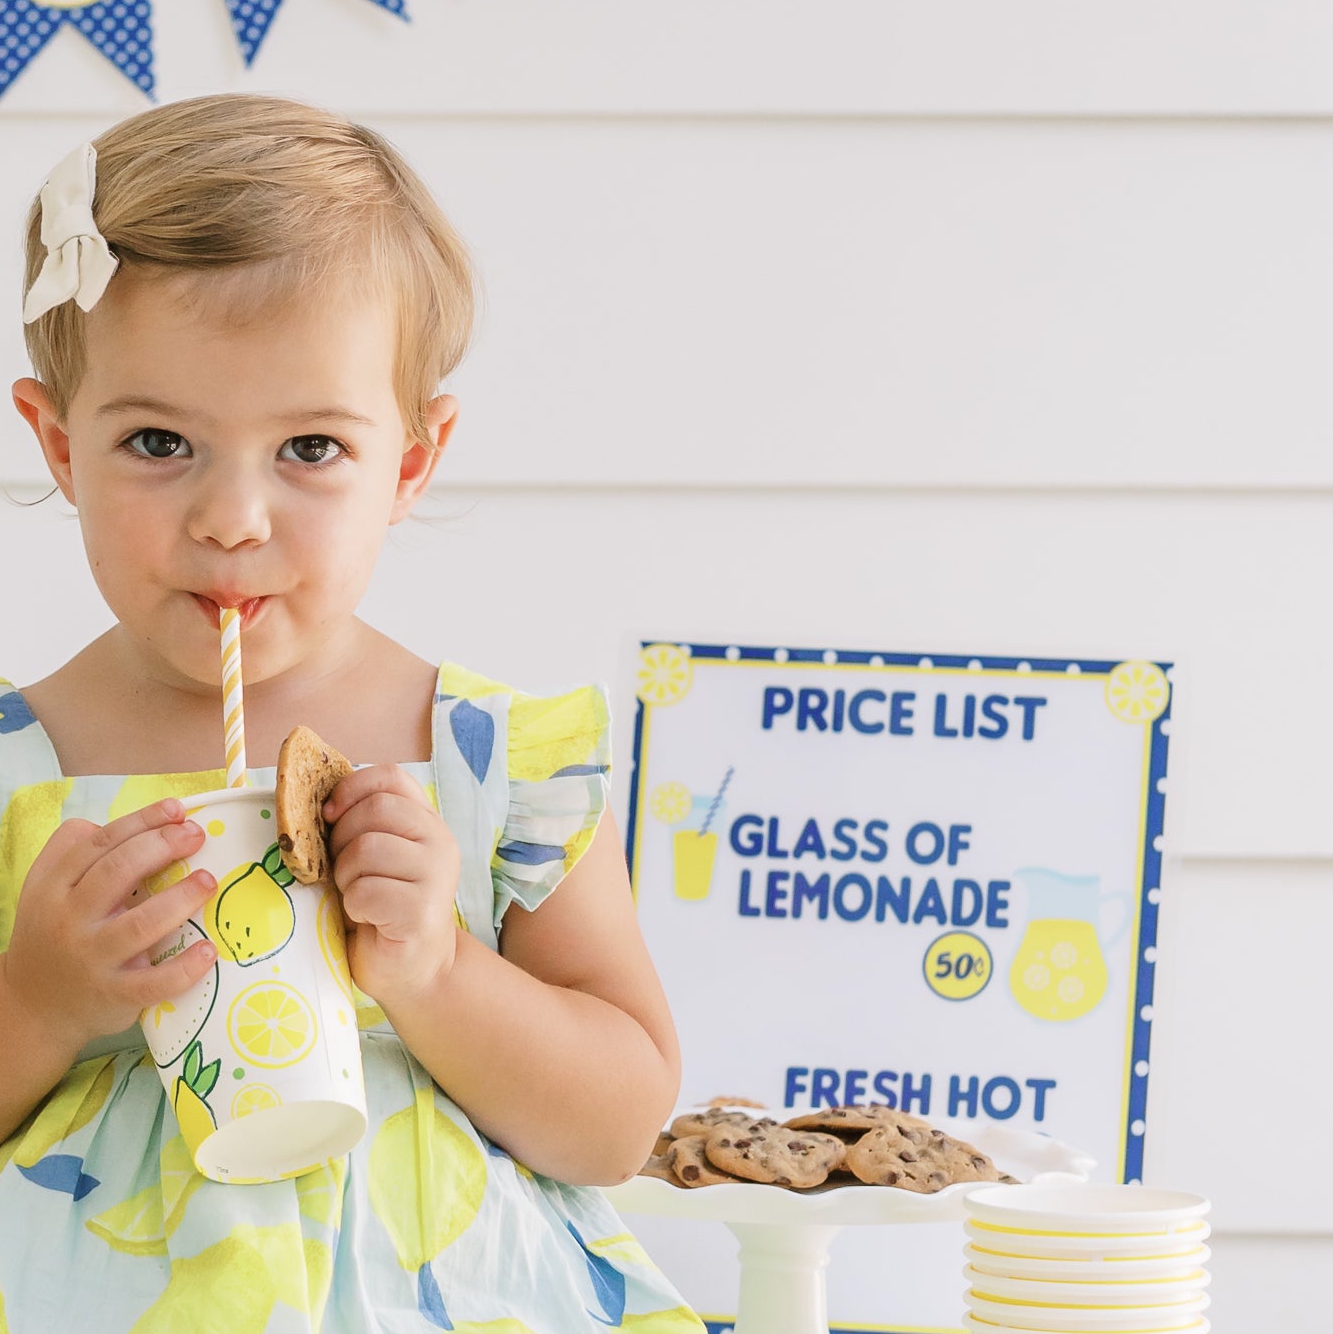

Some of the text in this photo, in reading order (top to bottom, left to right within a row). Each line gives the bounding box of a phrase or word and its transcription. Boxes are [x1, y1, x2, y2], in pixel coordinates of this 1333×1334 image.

[760, 685, 1049, 742] PRICE LIST
[728, 813, 973, 867] GLASS OF
[738, 869, 1012, 929] LEMONADE
[783, 1066, 1058, 1123] FRESH HOT
